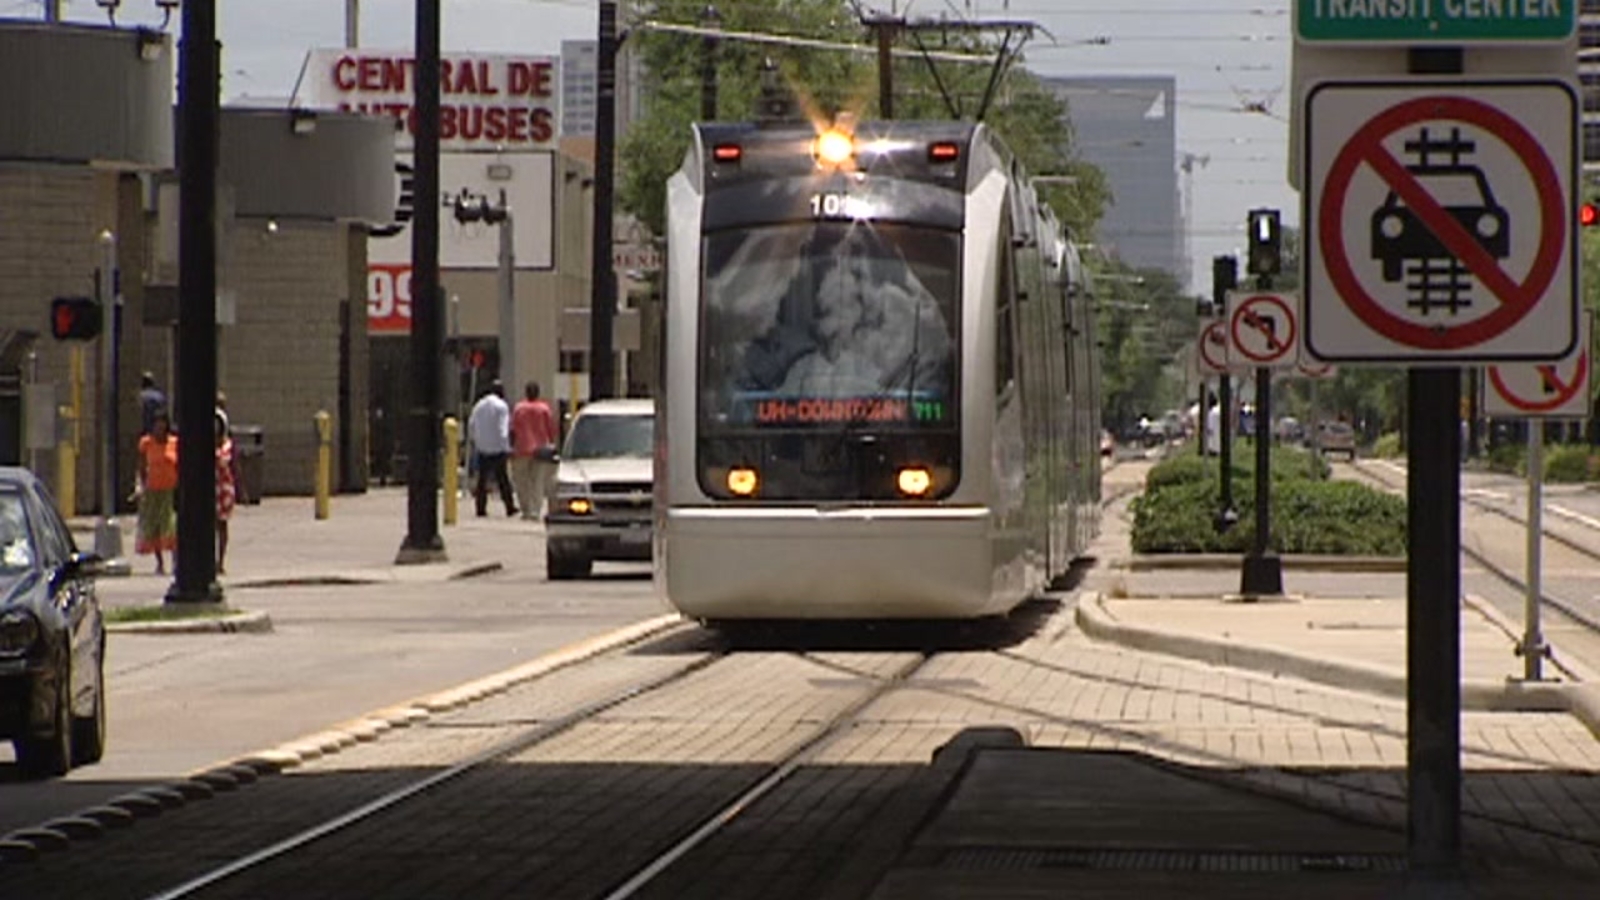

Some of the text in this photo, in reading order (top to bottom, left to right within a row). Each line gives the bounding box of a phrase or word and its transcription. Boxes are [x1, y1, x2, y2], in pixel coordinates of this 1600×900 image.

[1313, 0, 1561, 18] TRANSIT CENTER
[333, 55, 553, 98] CENRAL DE
[338, 103, 553, 143] BUSES
